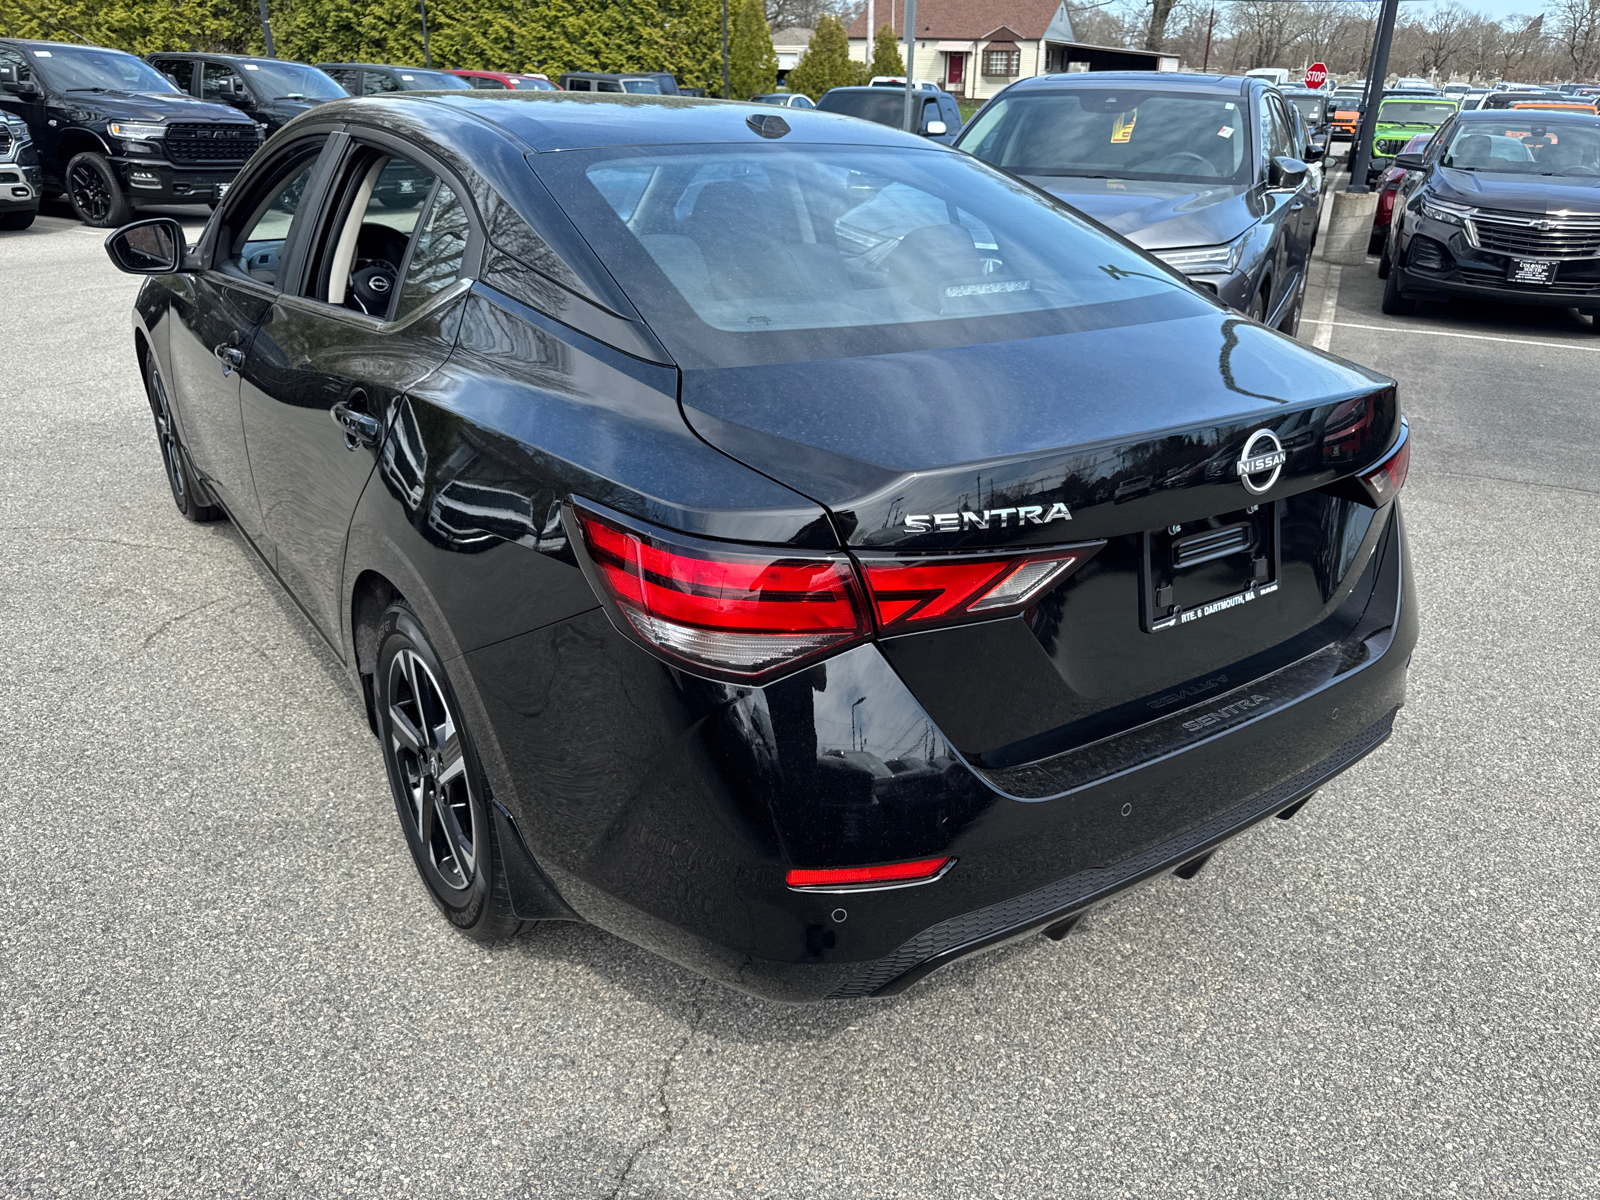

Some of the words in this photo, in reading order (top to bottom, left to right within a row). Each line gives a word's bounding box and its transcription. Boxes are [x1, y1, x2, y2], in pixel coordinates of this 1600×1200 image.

[1306, 70, 1326, 83] STOP
[1239, 451, 1286, 474] NISSAN
[902, 502, 1073, 535] SENTRA
[1181, 611, 1197, 623] RTE.
[1197, 609, 1202, 618] 6
[1204, 597, 1245, 616] DARTMOUTH,
[1245, 591, 1255, 601] MA
[1181, 694, 1271, 732] SENTRA
